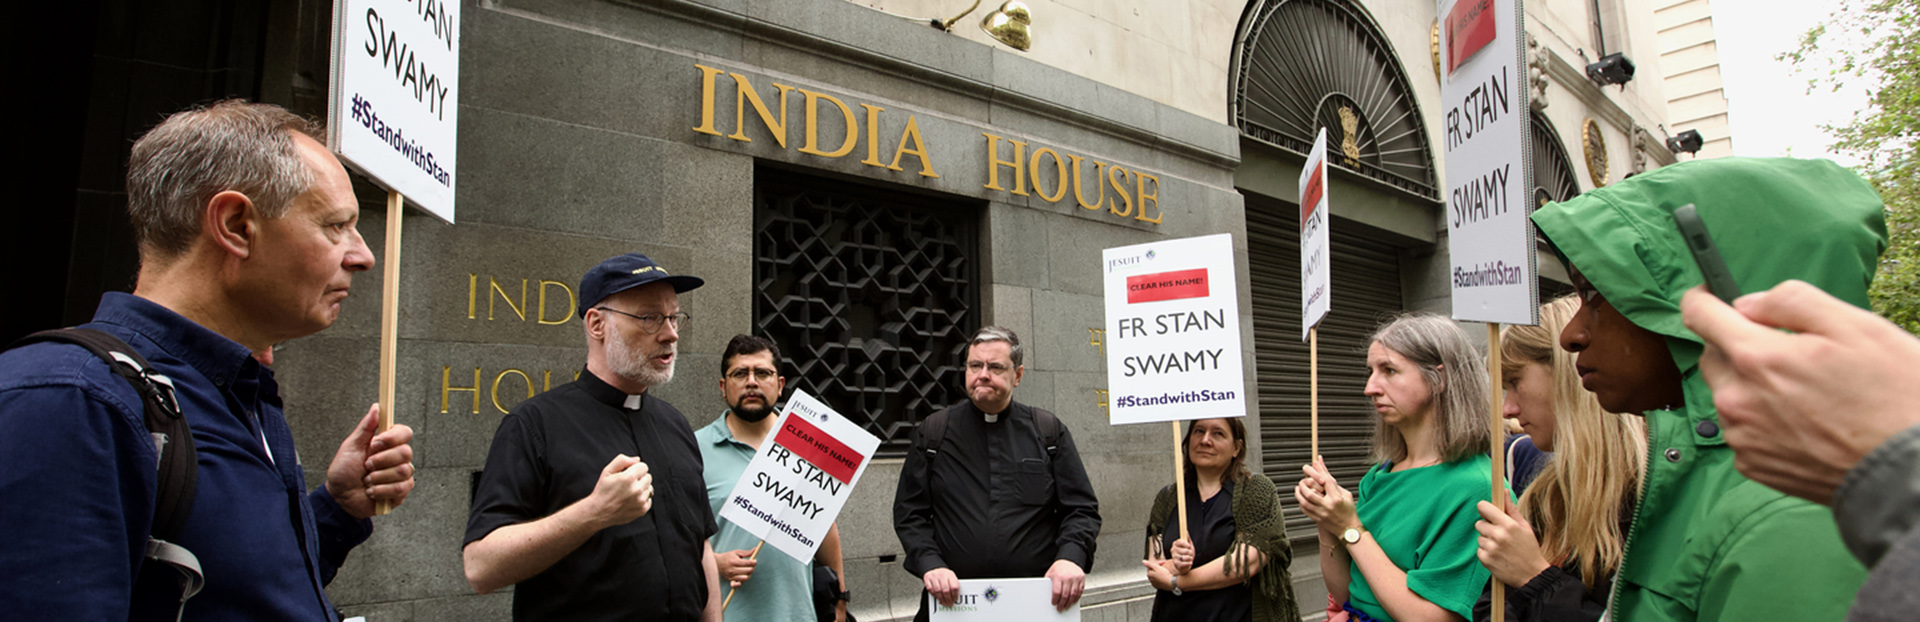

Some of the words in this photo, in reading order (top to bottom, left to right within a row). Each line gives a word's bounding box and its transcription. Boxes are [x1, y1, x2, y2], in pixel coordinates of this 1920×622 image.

[407, 0, 452, 52] AN
[365, 7, 448, 121] SWAMY
[1447, 106, 1463, 152] FR
[1464, 65, 1508, 139] STAN
[351, 93, 450, 187] #StandwithStan
[692, 64, 940, 179] INDIA
[982, 132, 1164, 225] HOUSE
[1453, 163, 1510, 228] SWAMY
[1109, 256, 1141, 273] JESUIT
[1130, 282, 1157, 292] CLEAR
[1159, 280, 1173, 289] HIS
[1175, 277, 1203, 287] NAME!
[1454, 260, 1522, 288] #StandwithStan
[468, 273, 576, 325] IND
[1118, 317, 1147, 339] FR
[1155, 308, 1225, 335] STAN
[1123, 348, 1223, 377] SWAMY
[791, 400, 818, 418] JESUIT
[1117, 389, 1235, 408] #StandwithStan
[767, 443, 791, 467] FR
[792, 458, 842, 496] STAN
[786, 424, 814, 447] CLEAR
[814, 439, 830, 454] HIS
[829, 448, 857, 471] NAME!
[752, 471, 824, 520] SWAMY
[733, 495, 814, 548] #StandwithStan
[933, 594, 978, 614] JUIT
